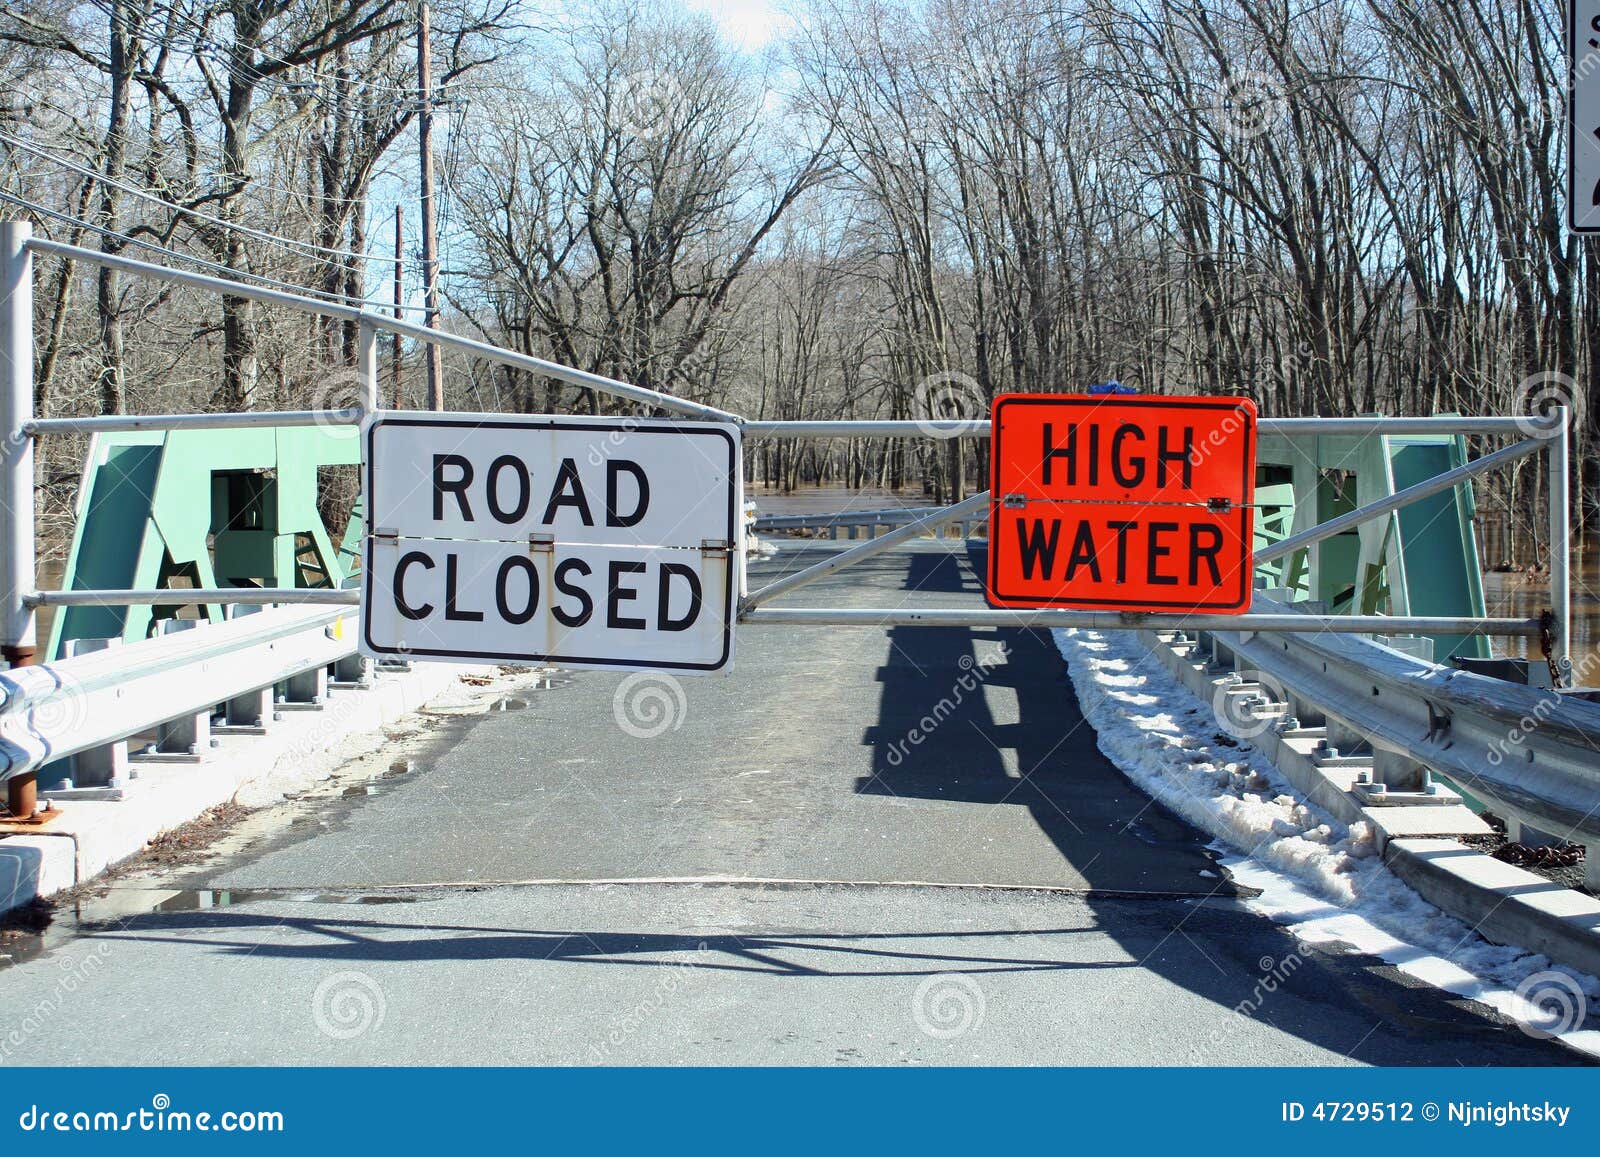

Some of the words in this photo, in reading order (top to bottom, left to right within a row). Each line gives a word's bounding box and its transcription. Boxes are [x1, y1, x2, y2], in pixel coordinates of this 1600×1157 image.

[432, 453, 650, 528] ROAD
[1042, 422, 1194, 490] HIGH
[1016, 518, 1224, 587] WATER
[392, 550, 703, 632] CLOSED
